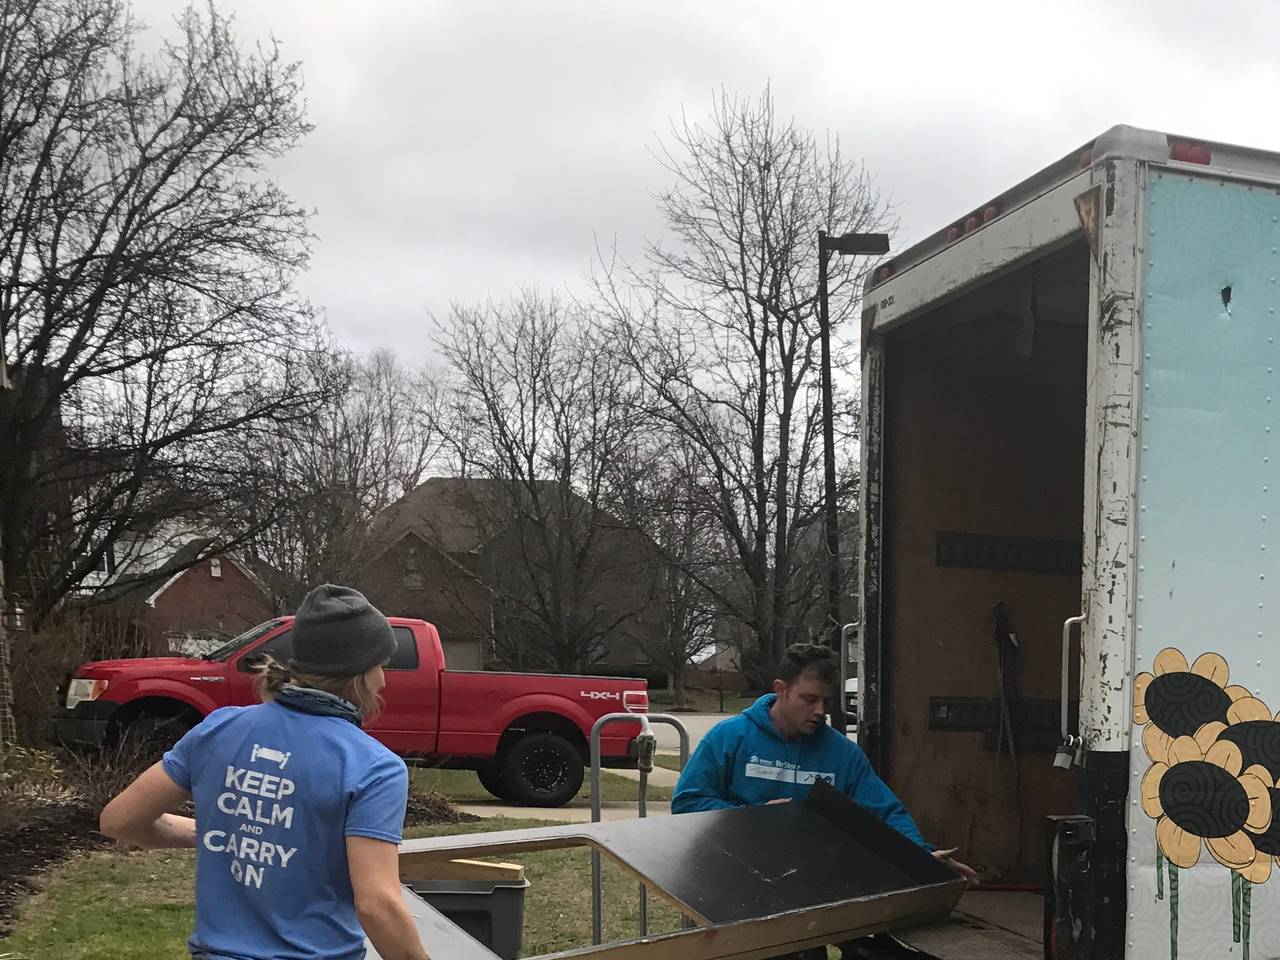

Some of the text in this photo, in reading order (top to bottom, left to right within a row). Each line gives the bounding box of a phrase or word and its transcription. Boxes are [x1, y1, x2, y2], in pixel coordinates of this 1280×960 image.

[224, 765, 296, 801] KEEP
[217, 792, 295, 830] CALM
[239, 823, 263, 835] AND
[203, 830, 299, 868] CARRY
[230, 859, 265, 889] ON
